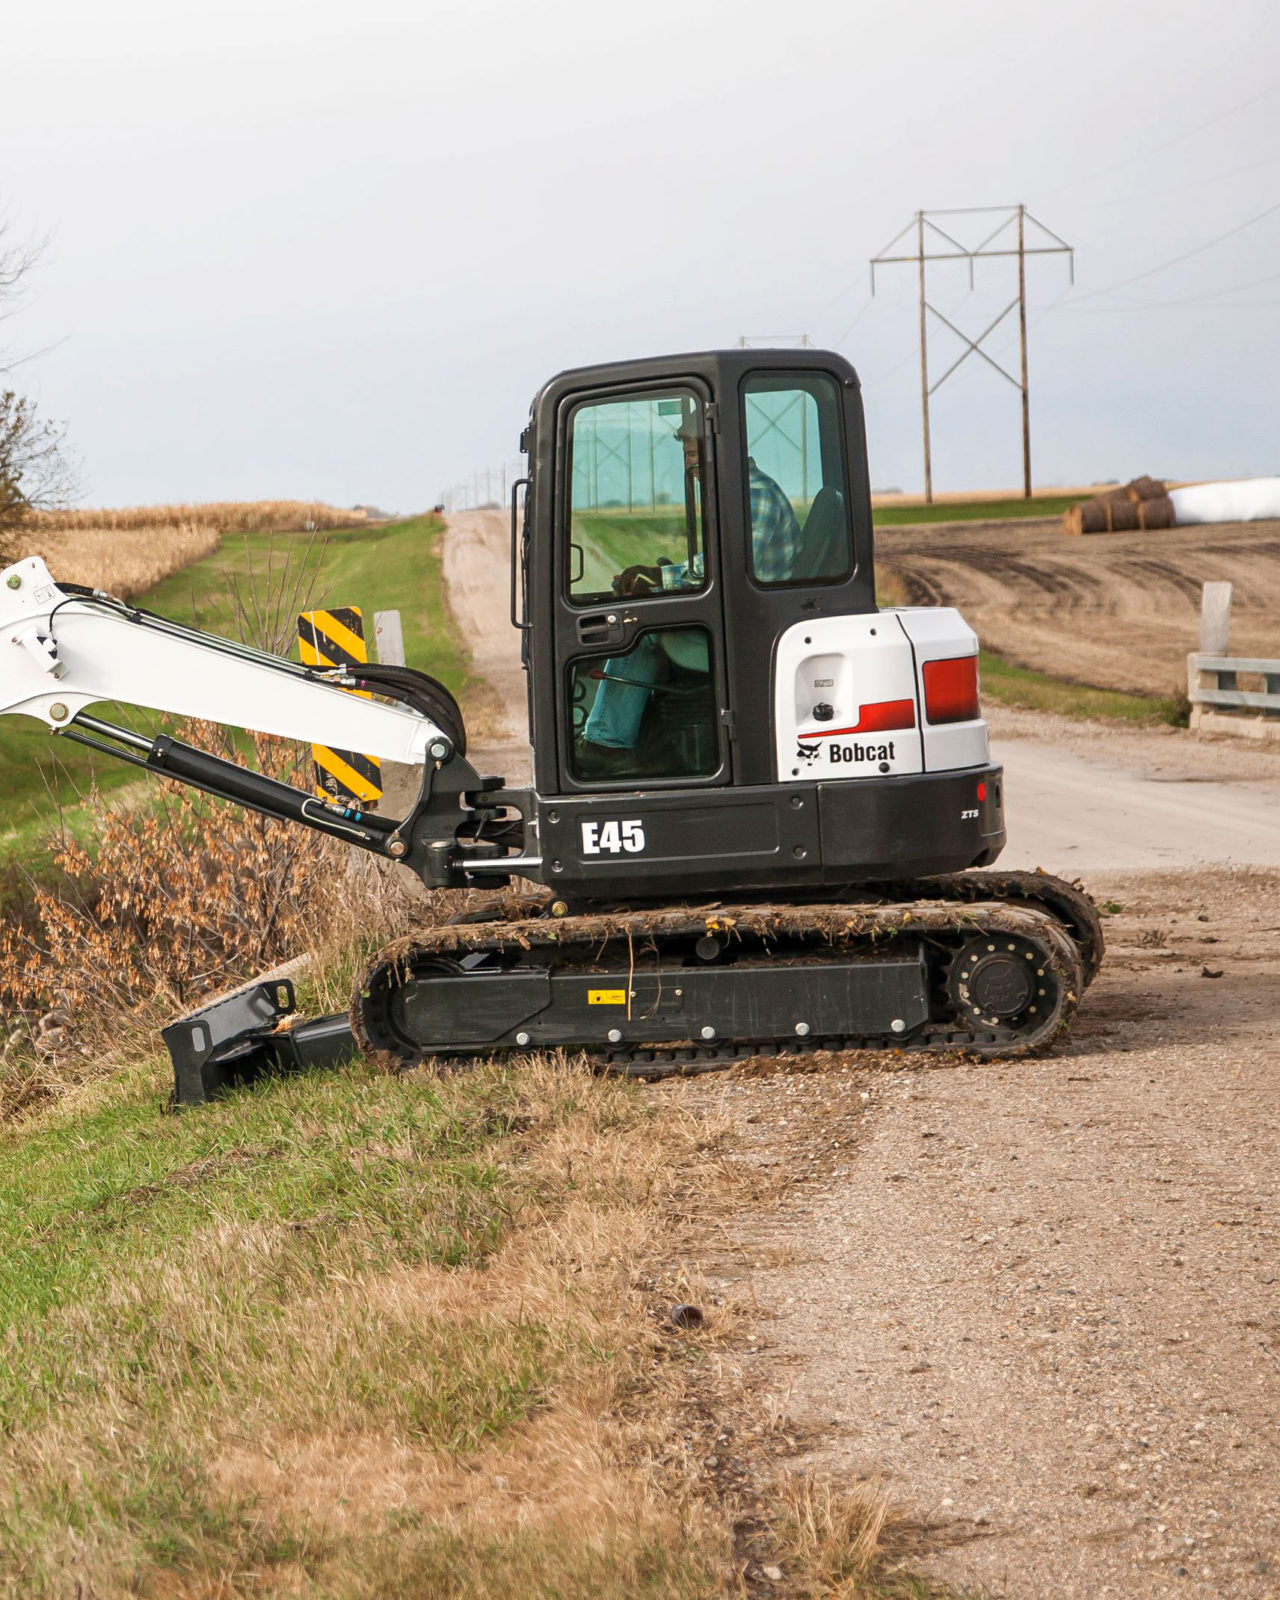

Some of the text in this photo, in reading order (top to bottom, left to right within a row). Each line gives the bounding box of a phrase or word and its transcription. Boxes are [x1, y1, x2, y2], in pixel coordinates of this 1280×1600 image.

[829, 741, 895, 763] Bobcat
[961, 809, 979, 819] ZTS
[581, 820, 645, 854] E45
